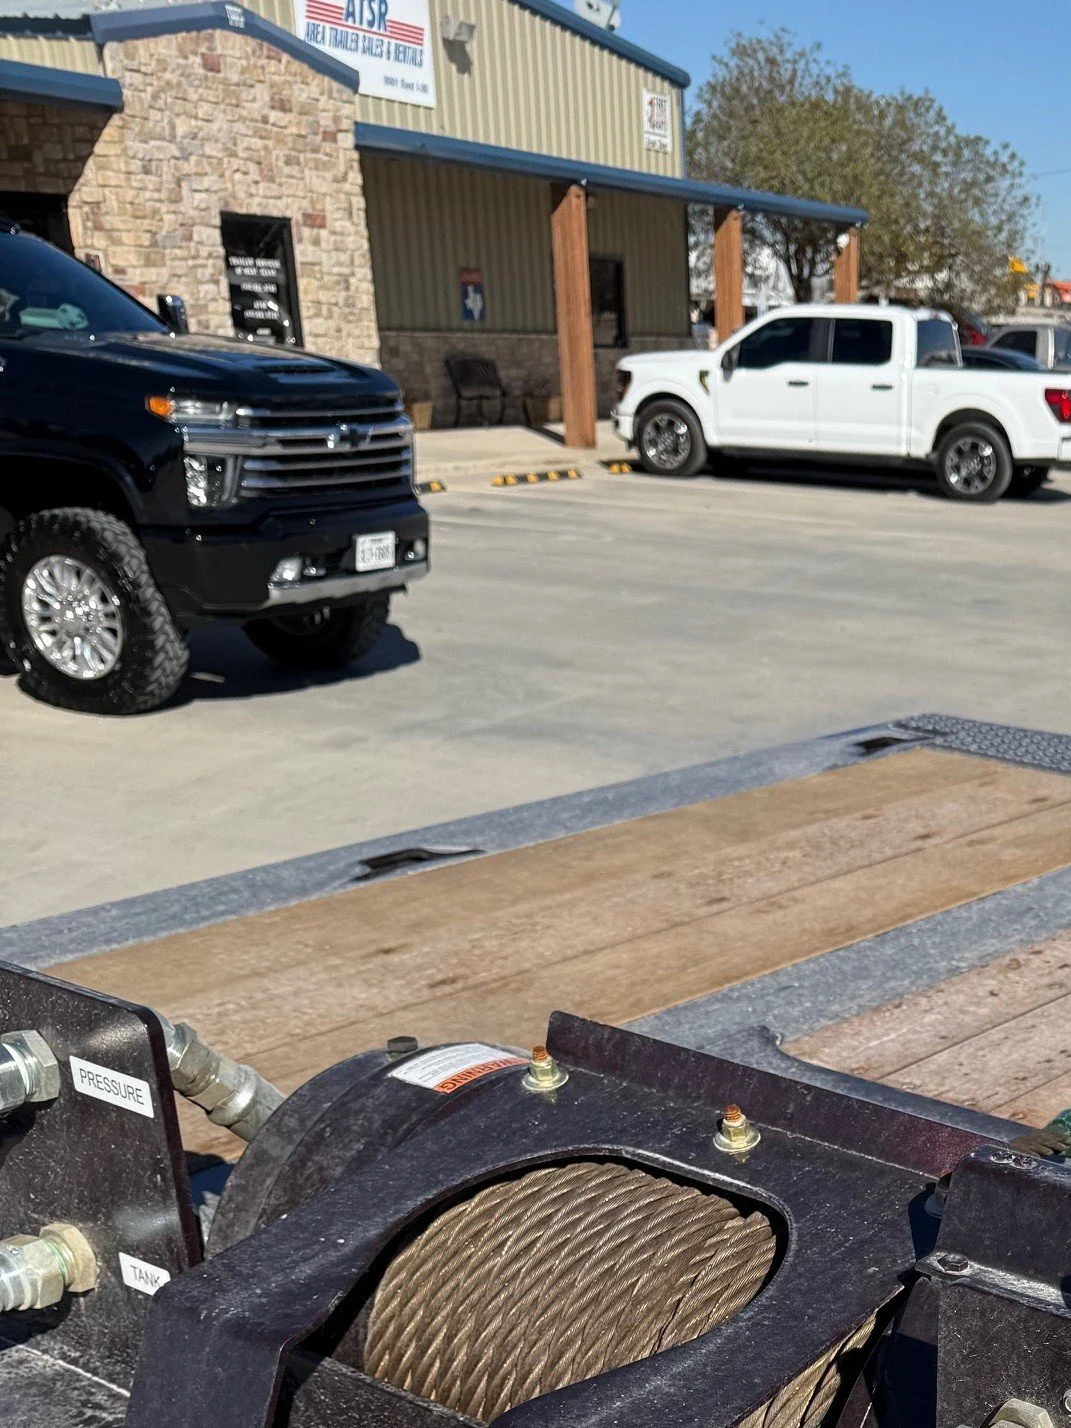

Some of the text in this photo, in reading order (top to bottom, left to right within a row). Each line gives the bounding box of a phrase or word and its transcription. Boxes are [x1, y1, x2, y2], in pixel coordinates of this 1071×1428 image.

[345, 0, 388, 33] ATSR
[305, 21, 325, 45] AREA
[329, 27, 359, 53] TRAILER
[362, 35, 383, 59] SALES
[394, 44, 423, 68] RENTALS
[80, 1068, 144, 1105] PRESSURE
[130, 1265, 160, 1287] TANK
